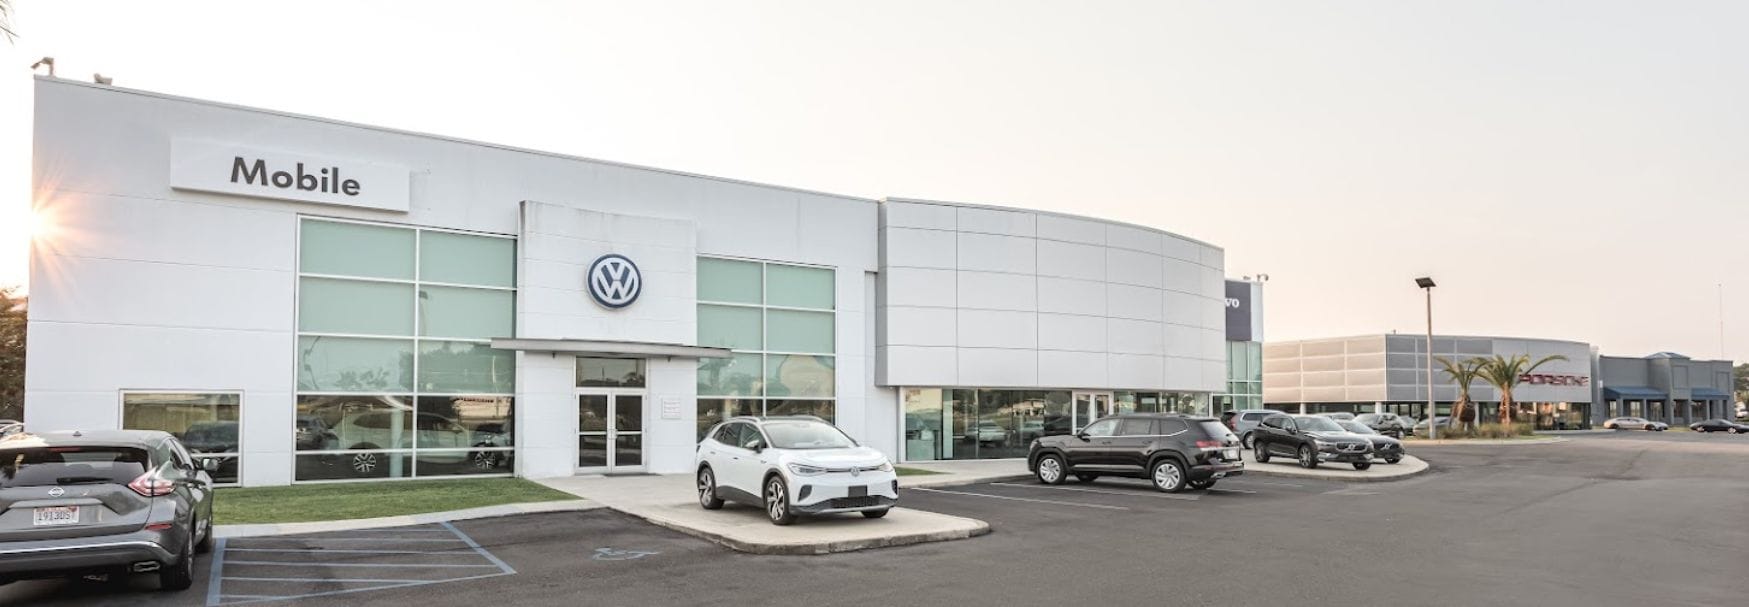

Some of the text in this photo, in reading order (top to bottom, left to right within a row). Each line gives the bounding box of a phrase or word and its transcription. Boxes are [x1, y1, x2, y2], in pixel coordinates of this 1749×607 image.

[230, 156, 361, 196] Mobile
[591, 257, 639, 305] VW
[1519, 374, 1589, 386] PORSCHE
